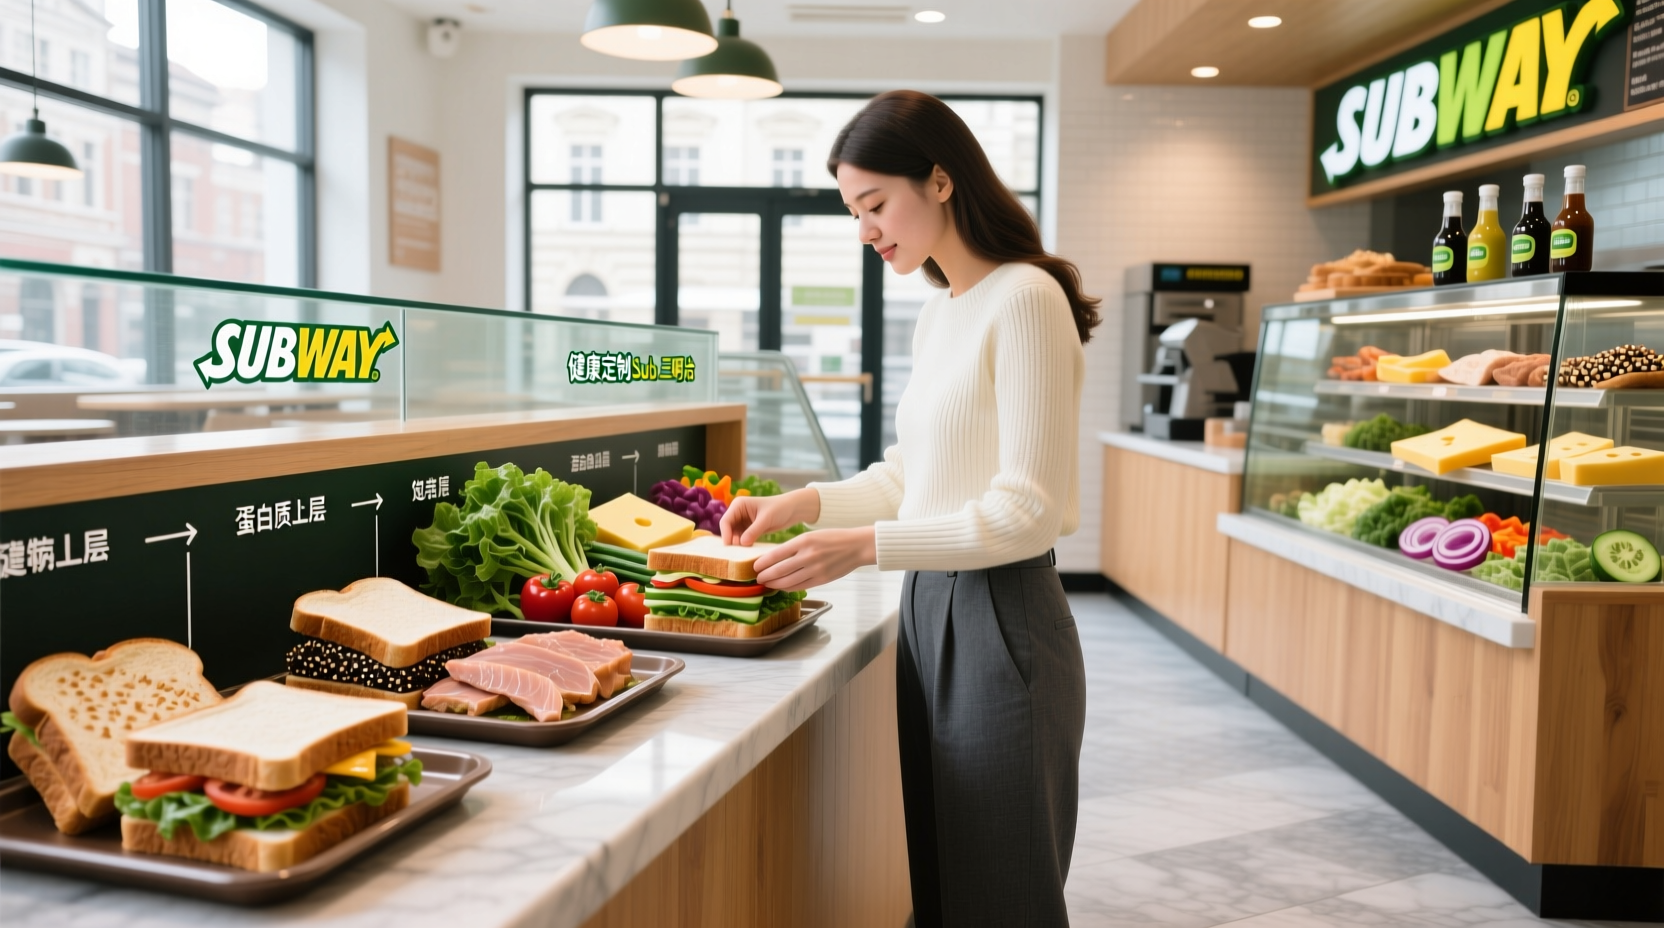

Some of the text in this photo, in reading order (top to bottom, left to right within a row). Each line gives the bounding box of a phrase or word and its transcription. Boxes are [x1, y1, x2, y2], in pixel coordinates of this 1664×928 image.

[1320, 0, 1620, 184] SUBWAY
[197, 322, 397, 384] SUBWAY
[235, 495, 327, 536] 蛋白质上层
